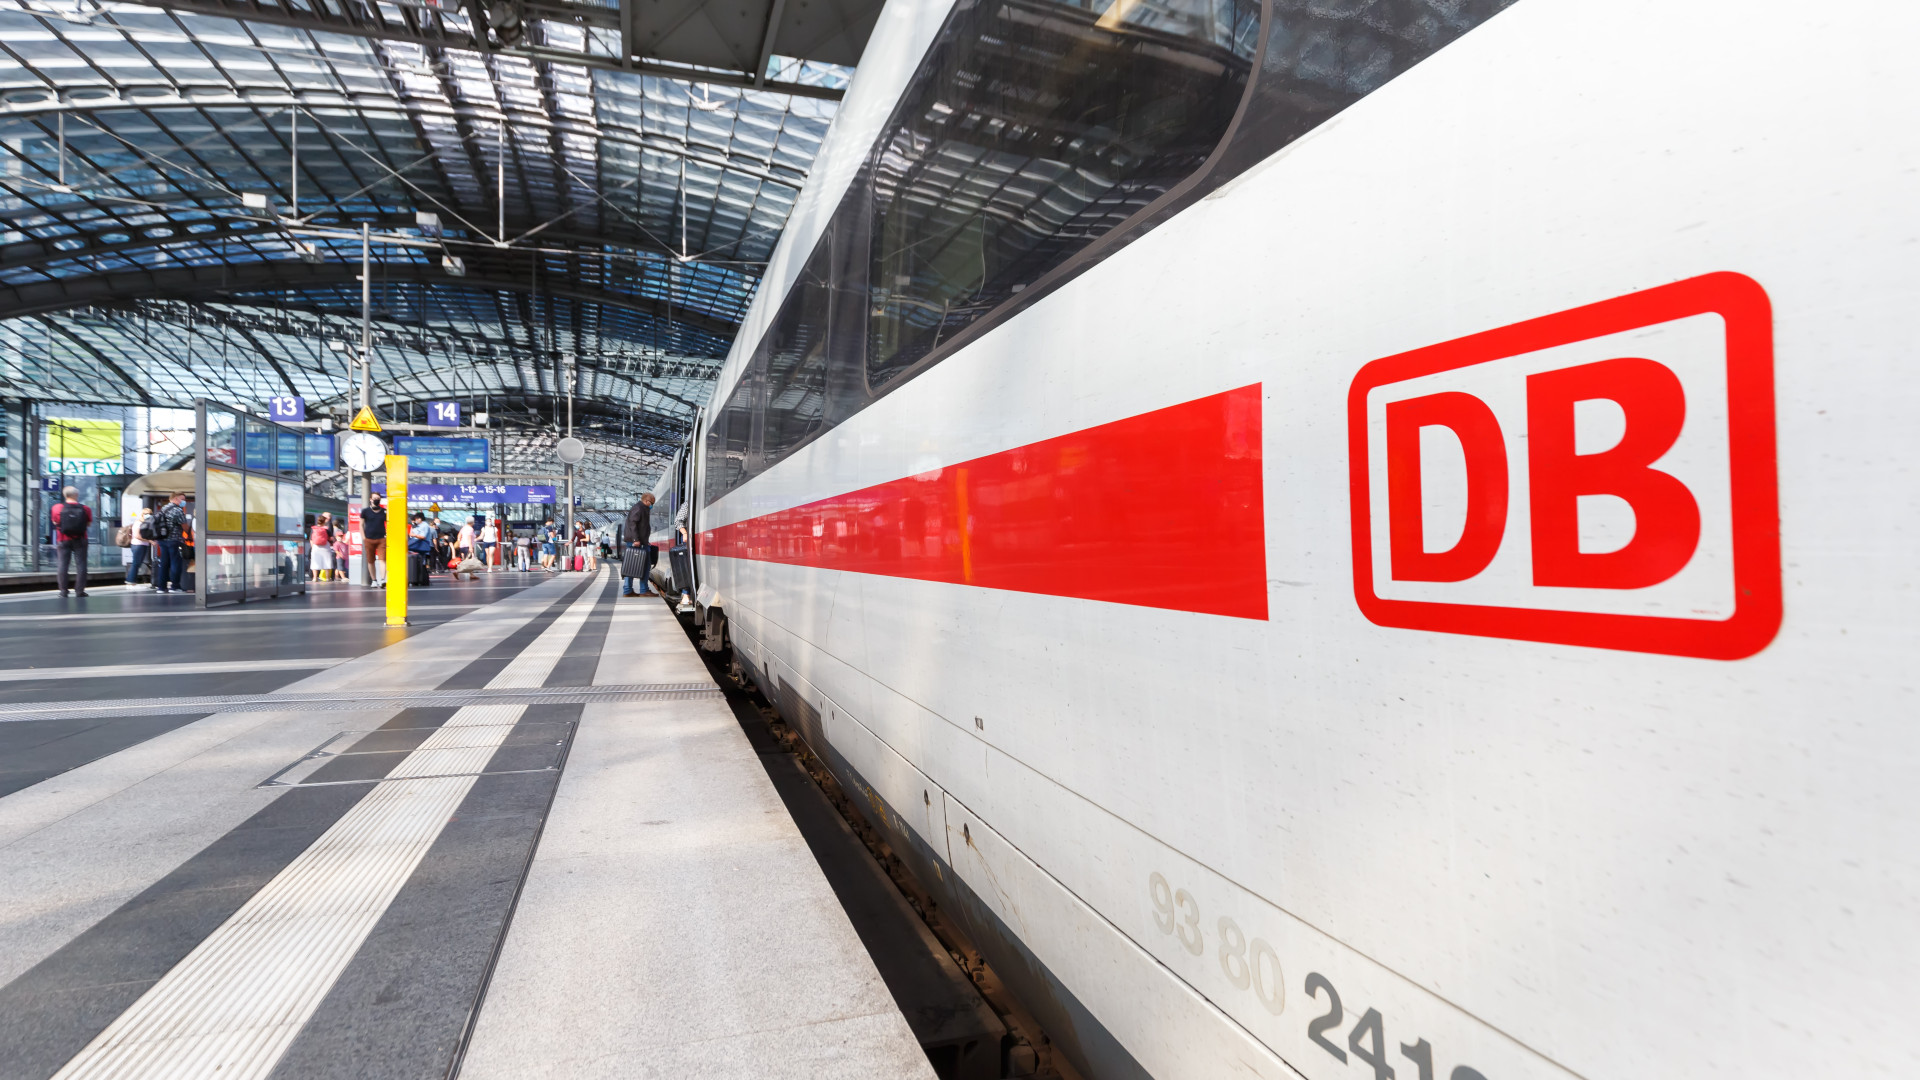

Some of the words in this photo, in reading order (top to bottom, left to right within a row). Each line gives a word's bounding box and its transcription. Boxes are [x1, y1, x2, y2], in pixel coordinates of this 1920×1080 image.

[272, 396, 297, 416] 13
[434, 403, 457, 421] 14
[48, 460, 121, 475] DATEV
[1386, 357, 1702, 590] DB
[48, 478, 58, 489] F
[460, 485, 477, 494] 1-12
[484, 485, 506, 494] 15-16
[574, 495, 581, 505] F
[1149, 871, 1204, 956] 93
[1216, 915, 1286, 1016] 80
[1304, 971, 1488, 1080] 241
